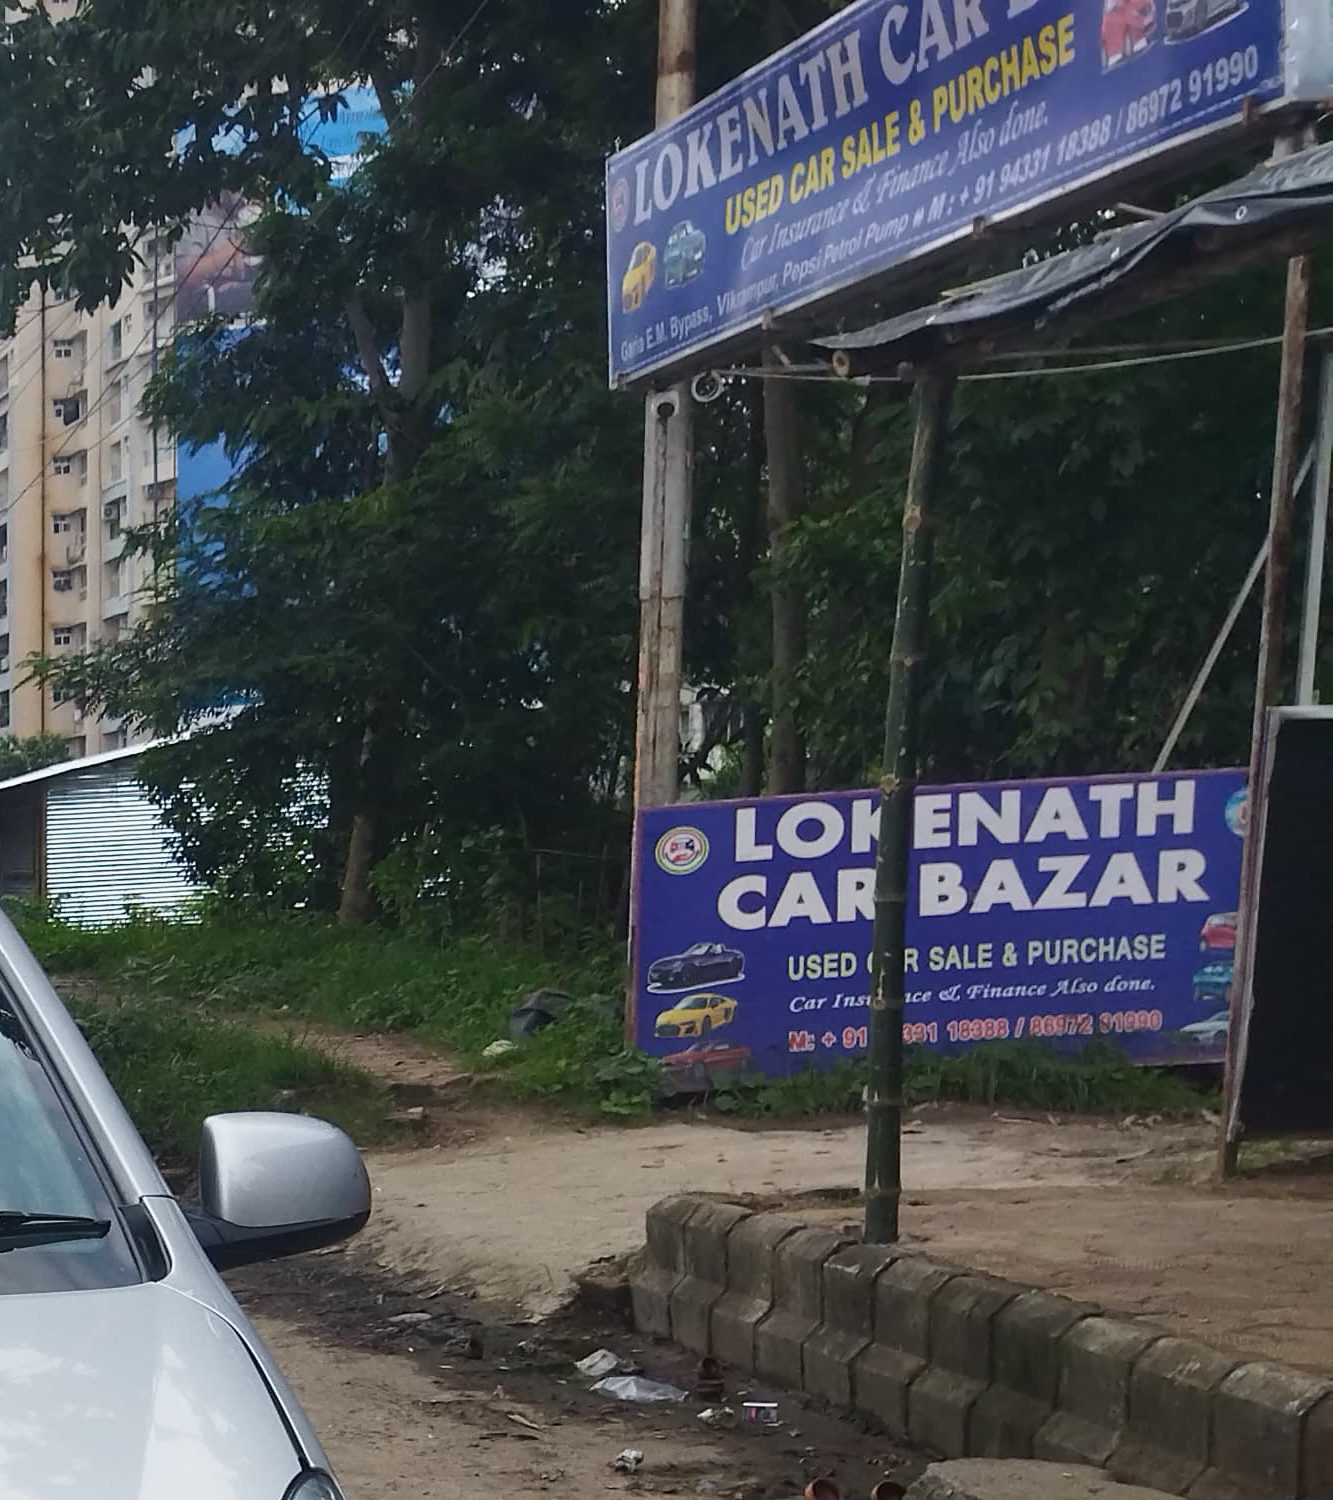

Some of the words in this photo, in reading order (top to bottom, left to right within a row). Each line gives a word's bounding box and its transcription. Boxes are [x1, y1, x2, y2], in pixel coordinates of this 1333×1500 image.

[633, 30, 868, 226] LOKENATH
[724, 173, 785, 235] USED
[790, 146, 835, 204] CAR
[841, 110, 900, 179] SALE
[908, 99, 926, 146] &
[933, 13, 1076, 133] PURCHASE
[741, 234, 767, 271] Car
[768, 198, 850, 255] Insurance
[852, 172, 876, 215] &
[876, 150, 949, 204] Finance
[947, 117, 995, 177] Also
[999, 99, 1049, 147] done.
[670, 304, 713, 340] Bypass,
[783, 247, 822, 286] Pepsi
[823, 227, 863, 267] Petrol
[864, 212, 910, 248] Pump
[1125, 77, 1183, 134] 86972
[1188, 44, 1259, 104] 91990
[717, 867, 876, 931] CAR
[919, 848, 1211, 918] BAZAR
[788, 951, 857, 982] USED
[929, 943, 993, 971] SALE
[1001, 942, 1018, 967] &
[1027, 933, 1167, 966] PURCHASE
[789, 995, 827, 1013] Car
[938, 983, 962, 1002] &
[967, 981, 1047, 1000] Finance
[1049, 976, 1098, 998] Also
[1104, 974, 1155, 994] done.
[841, 1026, 869, 1049] 91
[947, 1017, 1010, 1042] 18388
[1029, 1013, 1095, 1037] 86972
